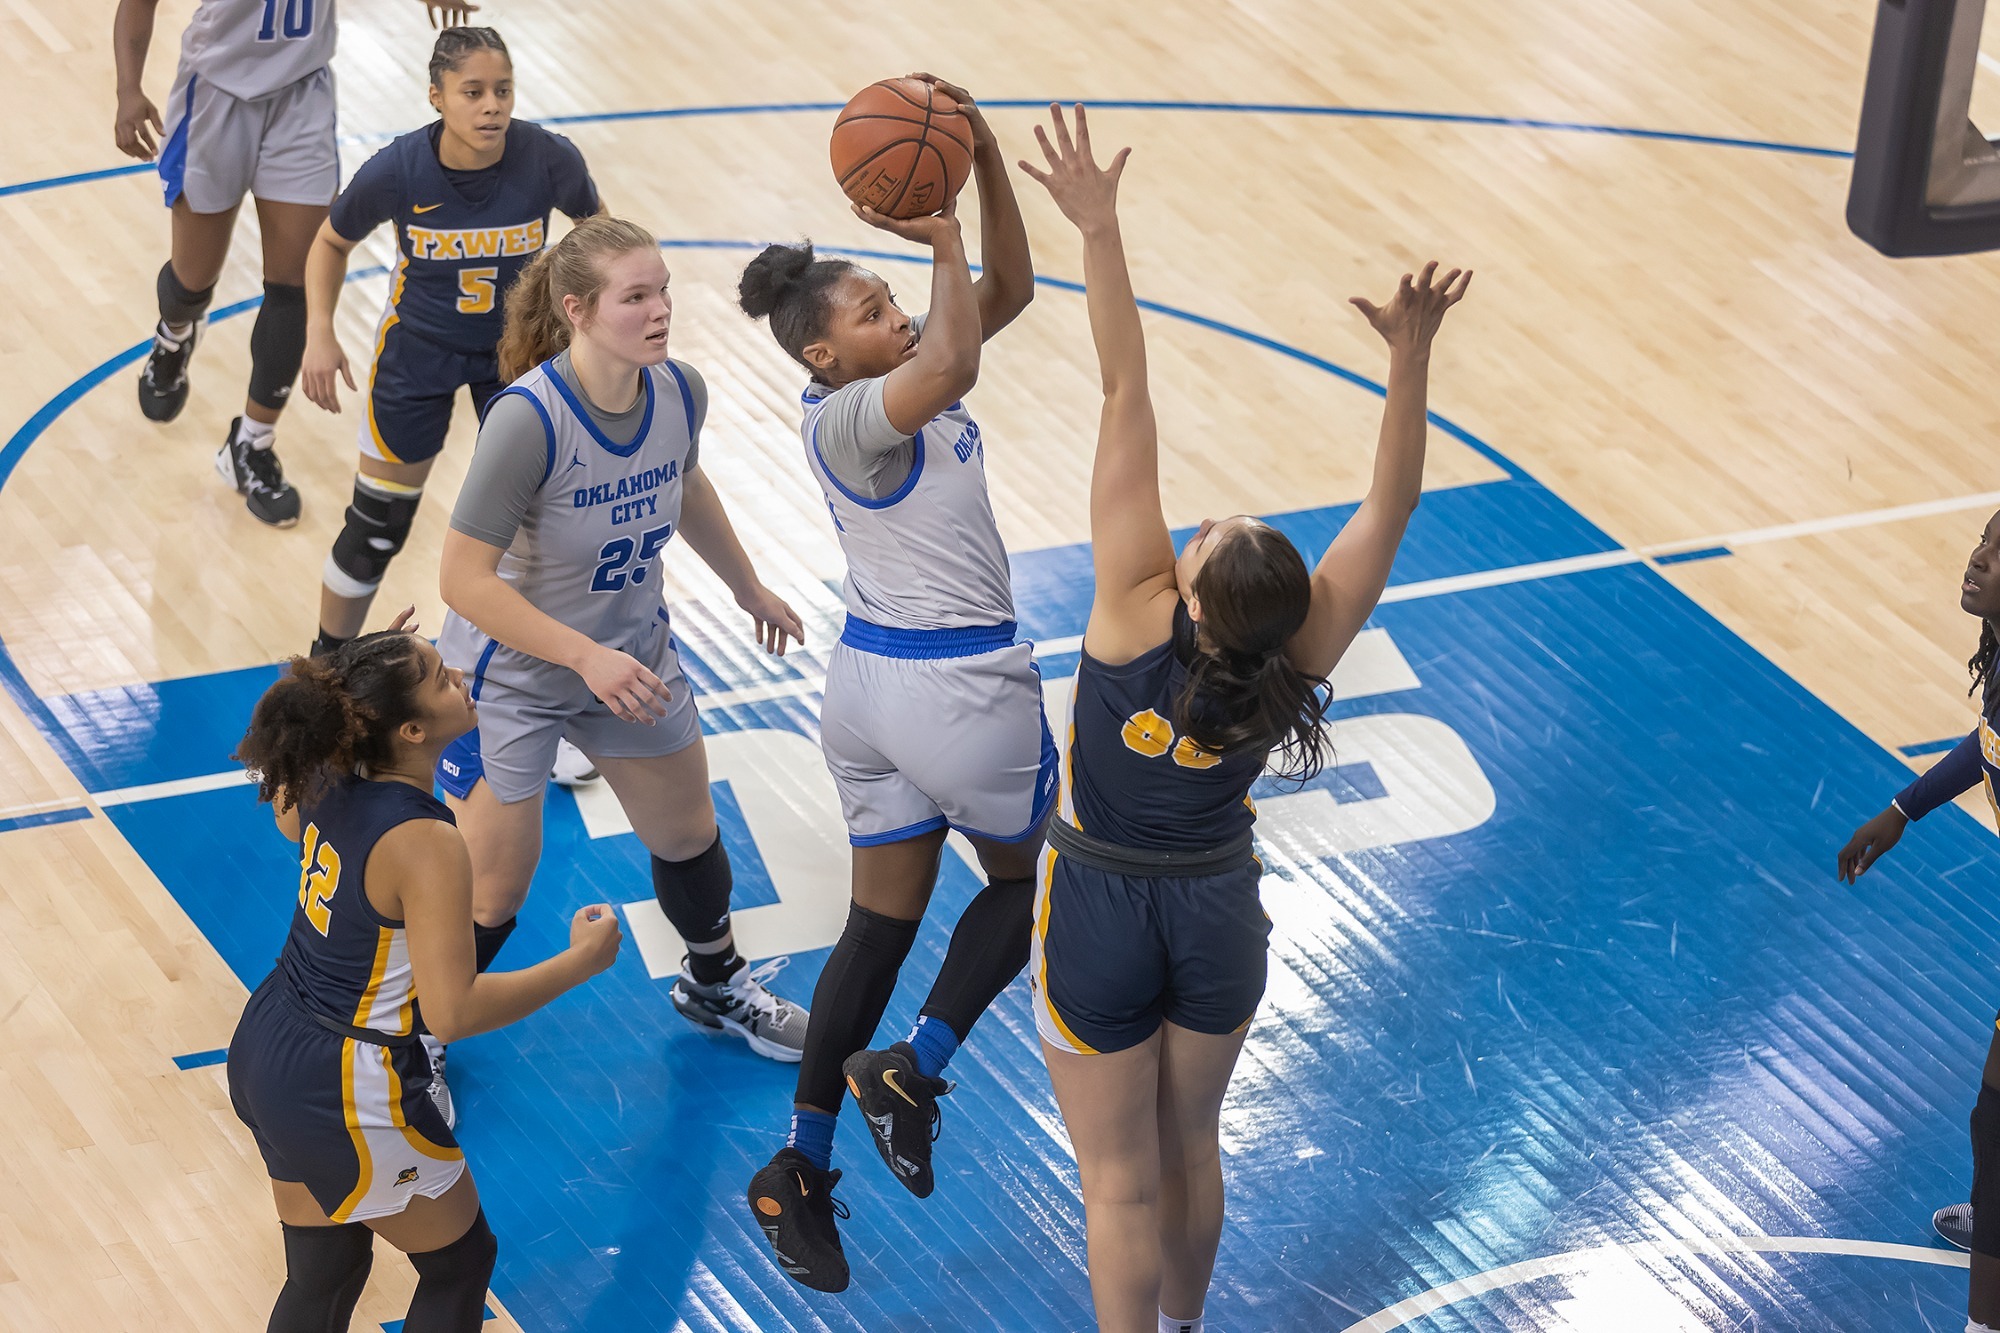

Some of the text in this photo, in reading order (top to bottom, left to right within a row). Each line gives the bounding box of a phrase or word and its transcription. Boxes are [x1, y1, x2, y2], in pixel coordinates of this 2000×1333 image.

[255, 0, 316, 42] 10
[406, 217, 546, 260] TXWES
[456, 267, 498, 314] 5
[574, 459, 679, 508] OKLAHOMA
[611, 493, 658, 526] CITY
[588, 520, 672, 594] 25
[442, 758, 460, 778] OCU
[299, 821, 341, 938] 12
